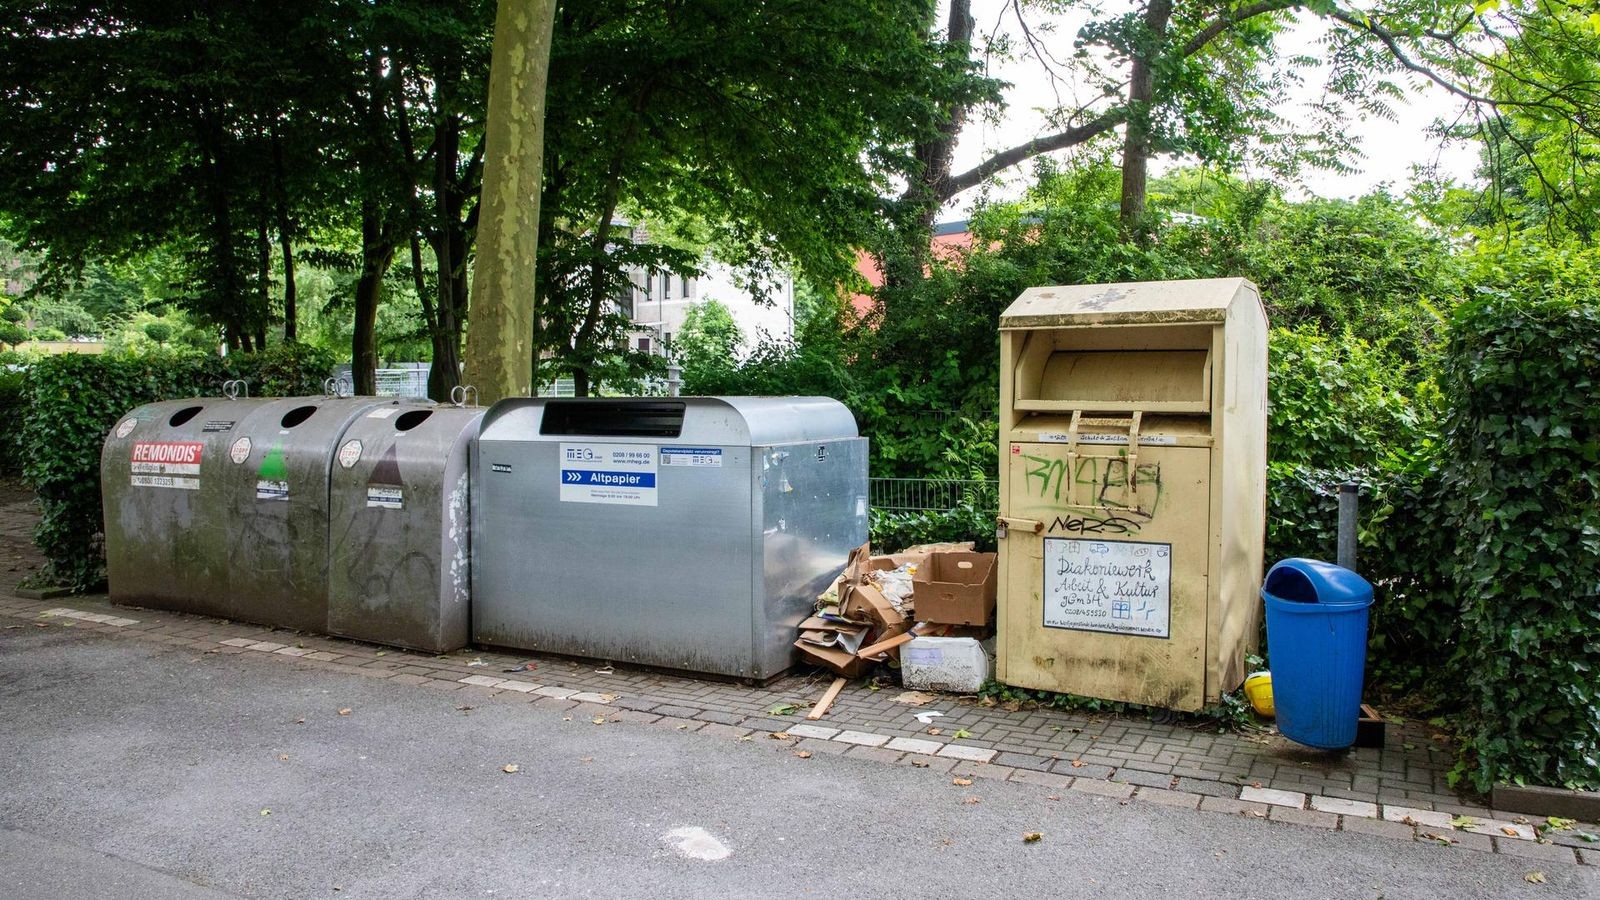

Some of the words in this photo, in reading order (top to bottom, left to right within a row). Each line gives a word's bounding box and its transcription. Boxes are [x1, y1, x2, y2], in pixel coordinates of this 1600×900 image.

[590, 472, 641, 485] Altpapier
[1057, 555, 1156, 581] Diakoniewerk
[1055, 577, 1094, 593] Arbeit
[1096, 578, 1110, 600] &
[1113, 581, 1160, 598] Kultur
